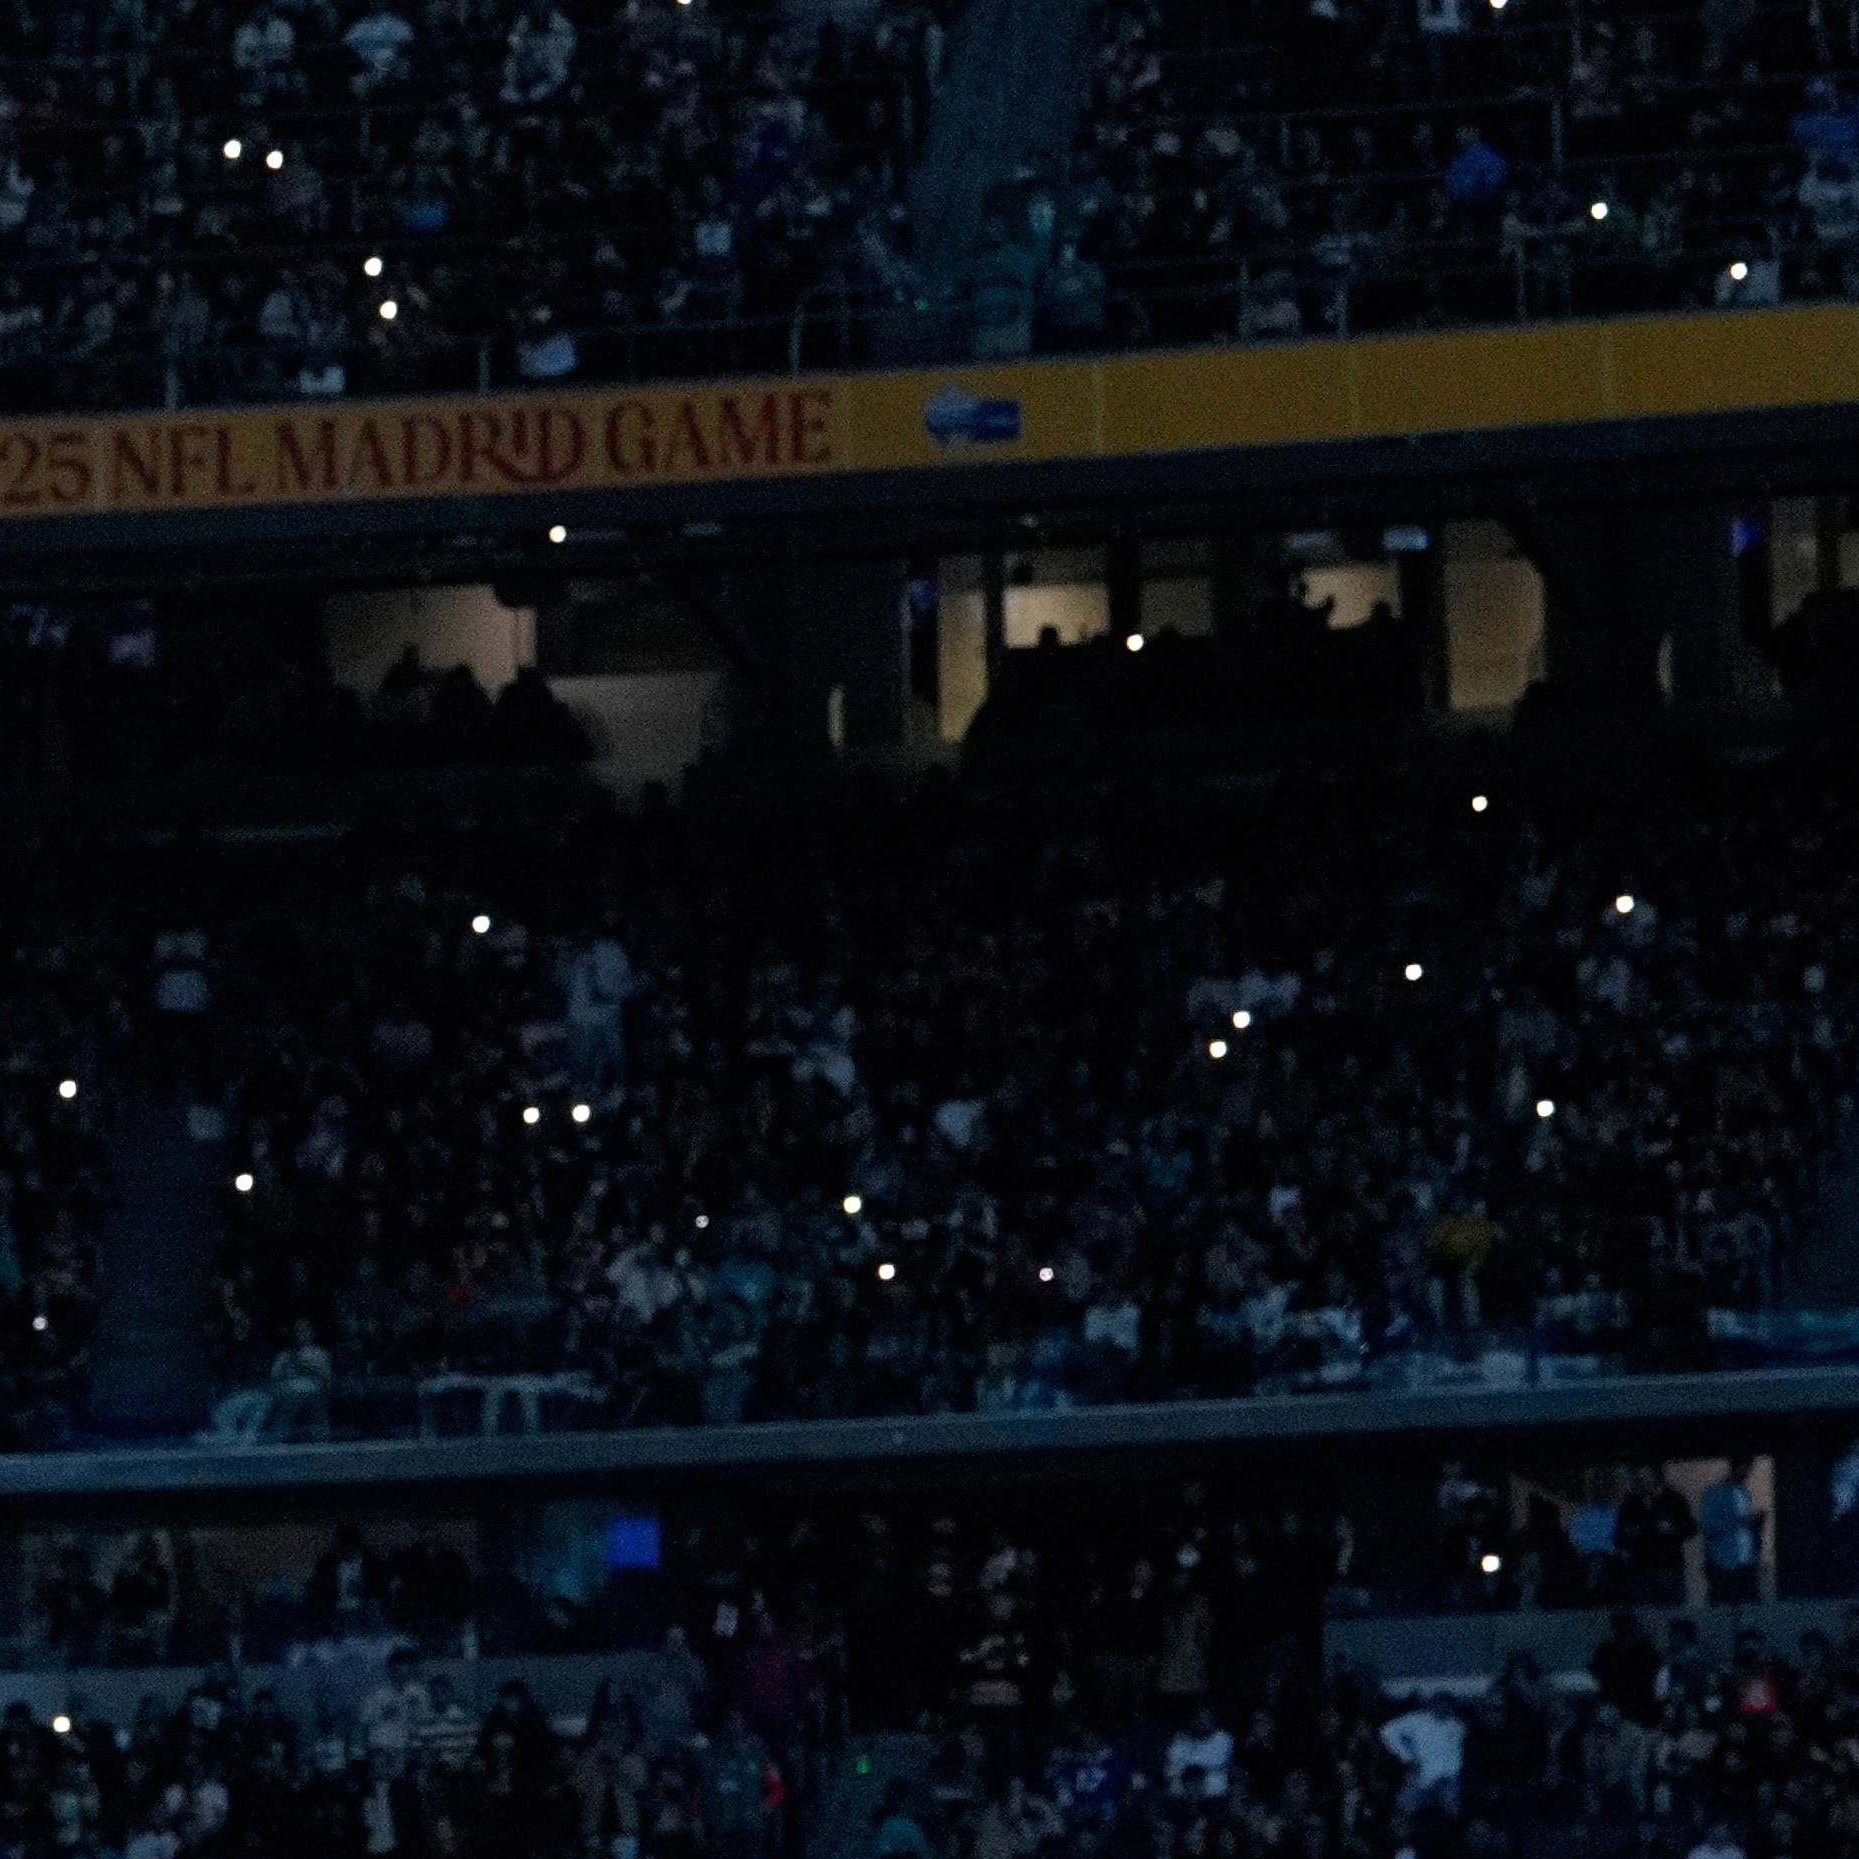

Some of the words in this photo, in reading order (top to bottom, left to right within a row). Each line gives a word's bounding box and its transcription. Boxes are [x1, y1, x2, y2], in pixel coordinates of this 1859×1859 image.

[114, 425, 254, 496] NFL
[279, 409, 583, 491] MADRID
[606, 390, 832, 476] GAME
